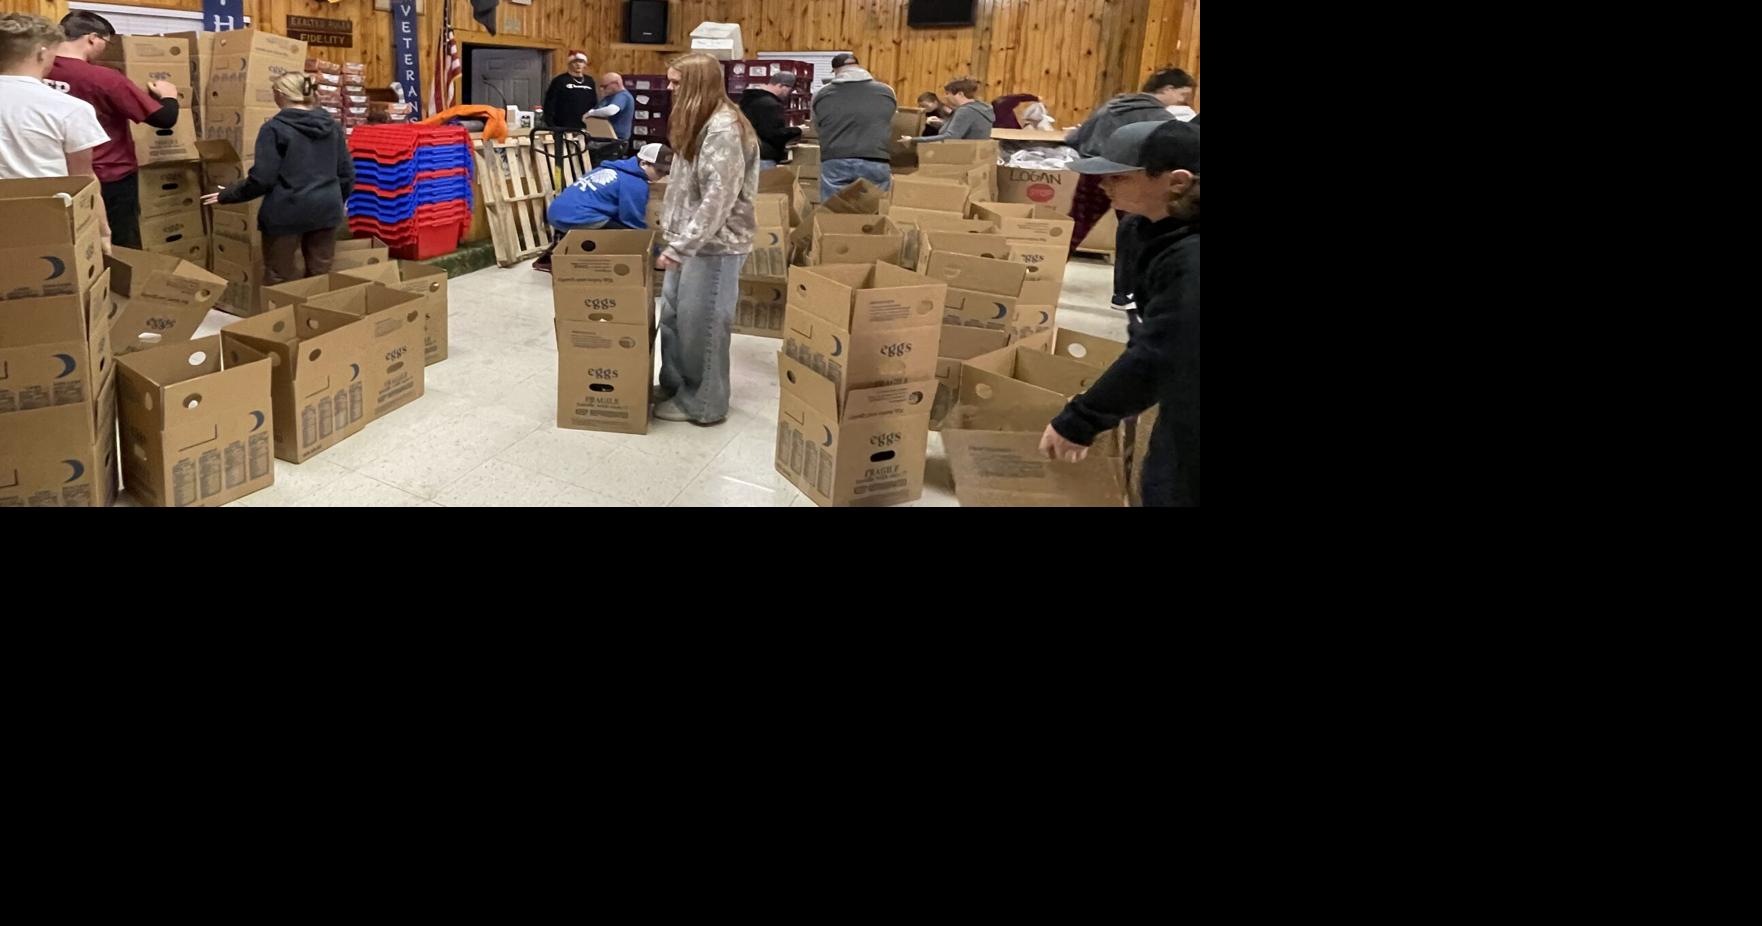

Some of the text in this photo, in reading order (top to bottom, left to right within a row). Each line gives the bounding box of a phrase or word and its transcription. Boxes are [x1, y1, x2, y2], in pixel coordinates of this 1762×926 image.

[300, 33, 345, 44] FIDELITY
[400, 5, 418, 123] VETERANS
[1010, 170, 1061, 185] LOGAN
[584, 297, 616, 310] eggs
[880, 341, 912, 358] eggs
[587, 367, 619, 380] eggs
[869, 431, 902, 447] eggs
